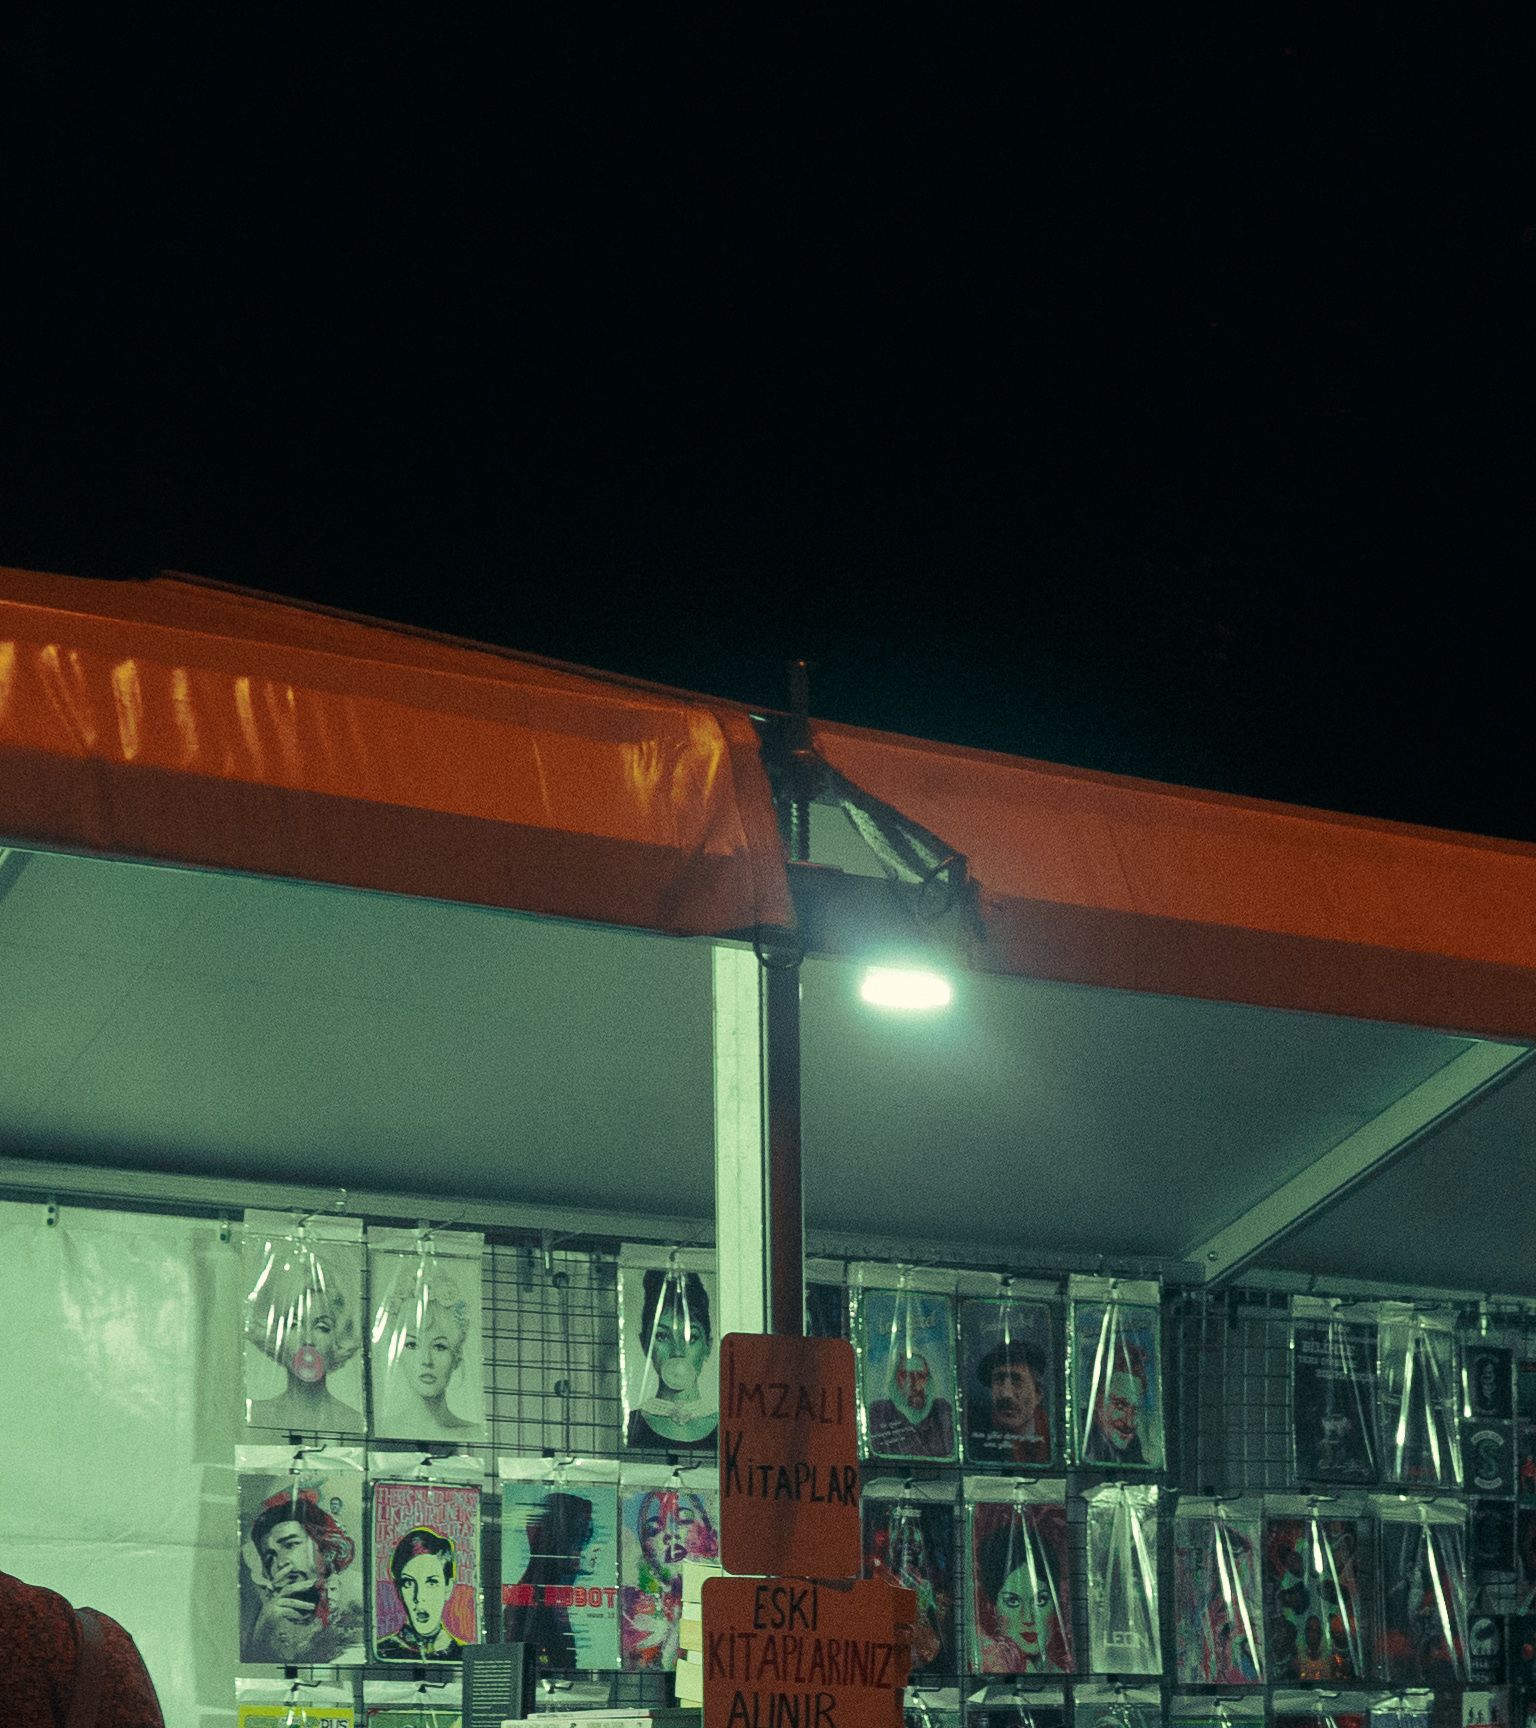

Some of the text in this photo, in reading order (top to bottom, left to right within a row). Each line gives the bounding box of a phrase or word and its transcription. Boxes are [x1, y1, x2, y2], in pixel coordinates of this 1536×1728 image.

[724, 1430, 858, 1507] KİTAPLAR
[753, 1580, 819, 1631] ESKİ
[707, 1626, 894, 1689] KİTAPLARINIZ
